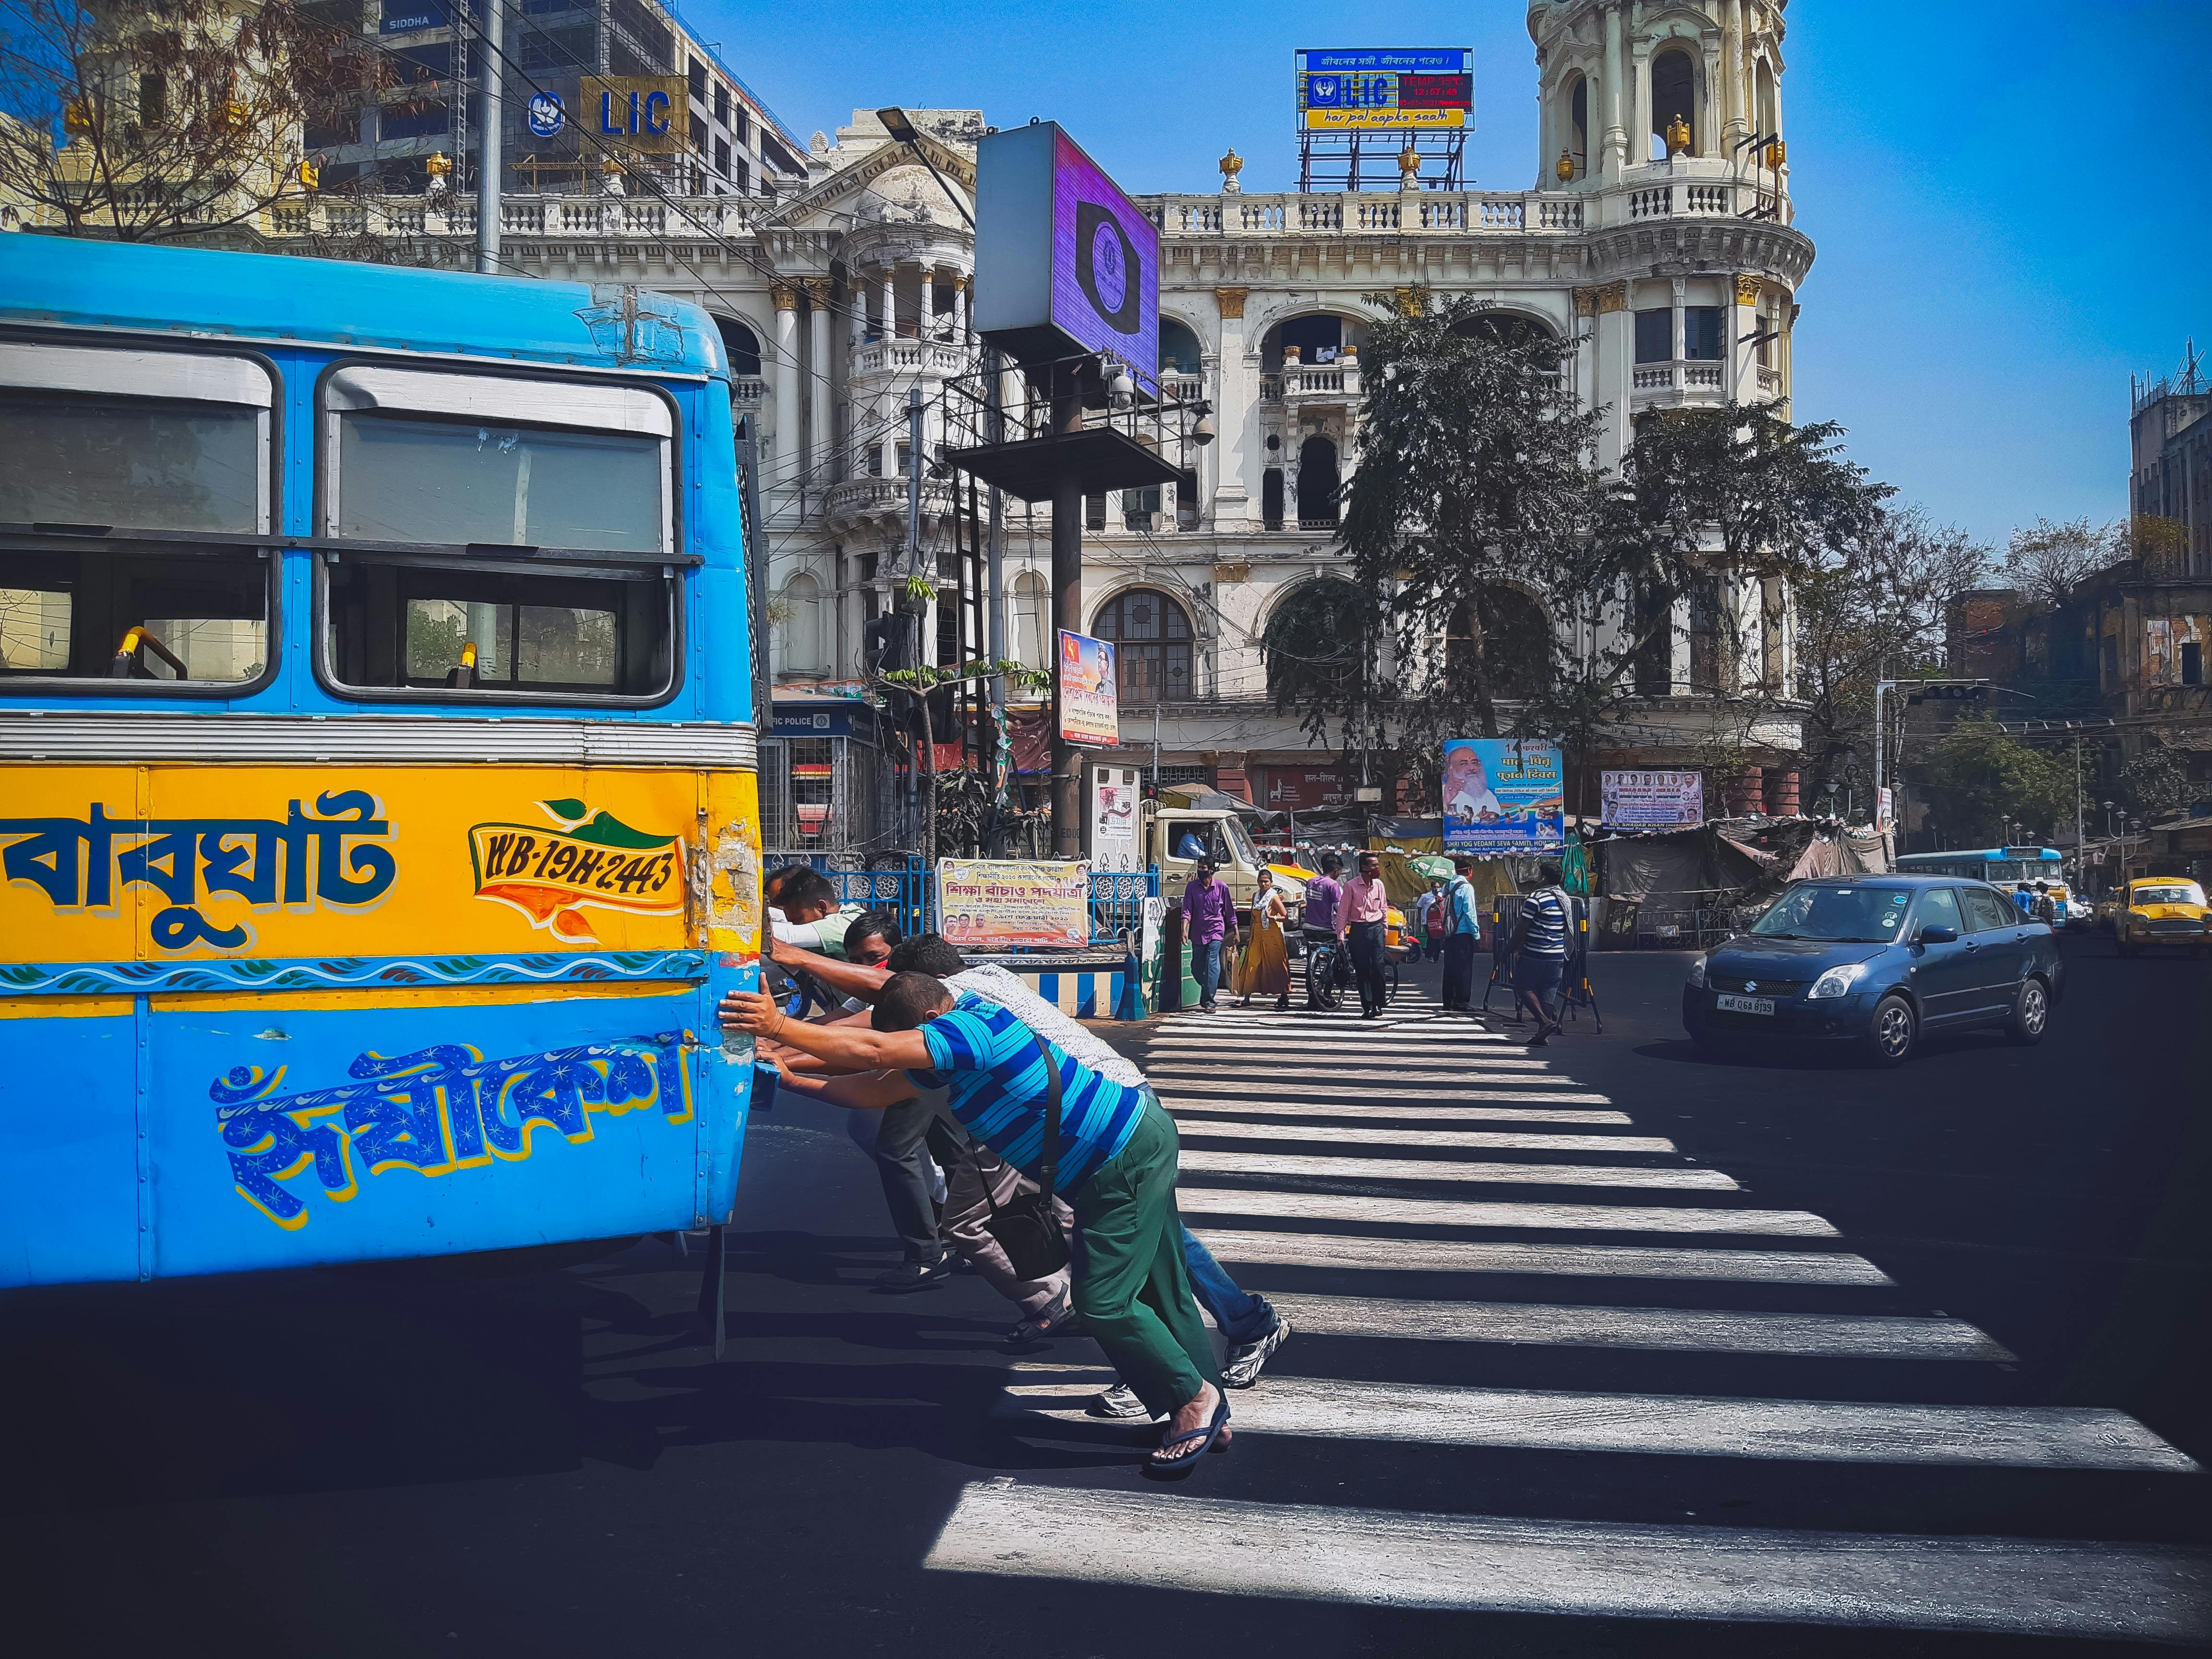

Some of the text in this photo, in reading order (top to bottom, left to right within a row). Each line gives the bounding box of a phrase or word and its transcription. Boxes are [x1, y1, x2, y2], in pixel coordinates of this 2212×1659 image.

[389, 15, 429, 30] SIDDHA
[1321, 56, 1357, 66] জীবনের
[1381, 55, 1417, 65] জীবনের
[1346, 78, 1388, 105] LIC
[602, 91, 671, 135] LIC
[1324, 108, 1448, 126] har pal aapke saath
[1527, 768, 1557, 780] दिवस
[0, 790, 397, 950] বাবুঘাট
[976, 871, 1000, 879] শিক্ষানীতি
[946, 881, 1082, 899] শিক্ষা বাঁচাও পদযাত্রা
[1724, 998, 1735, 1008] WB
